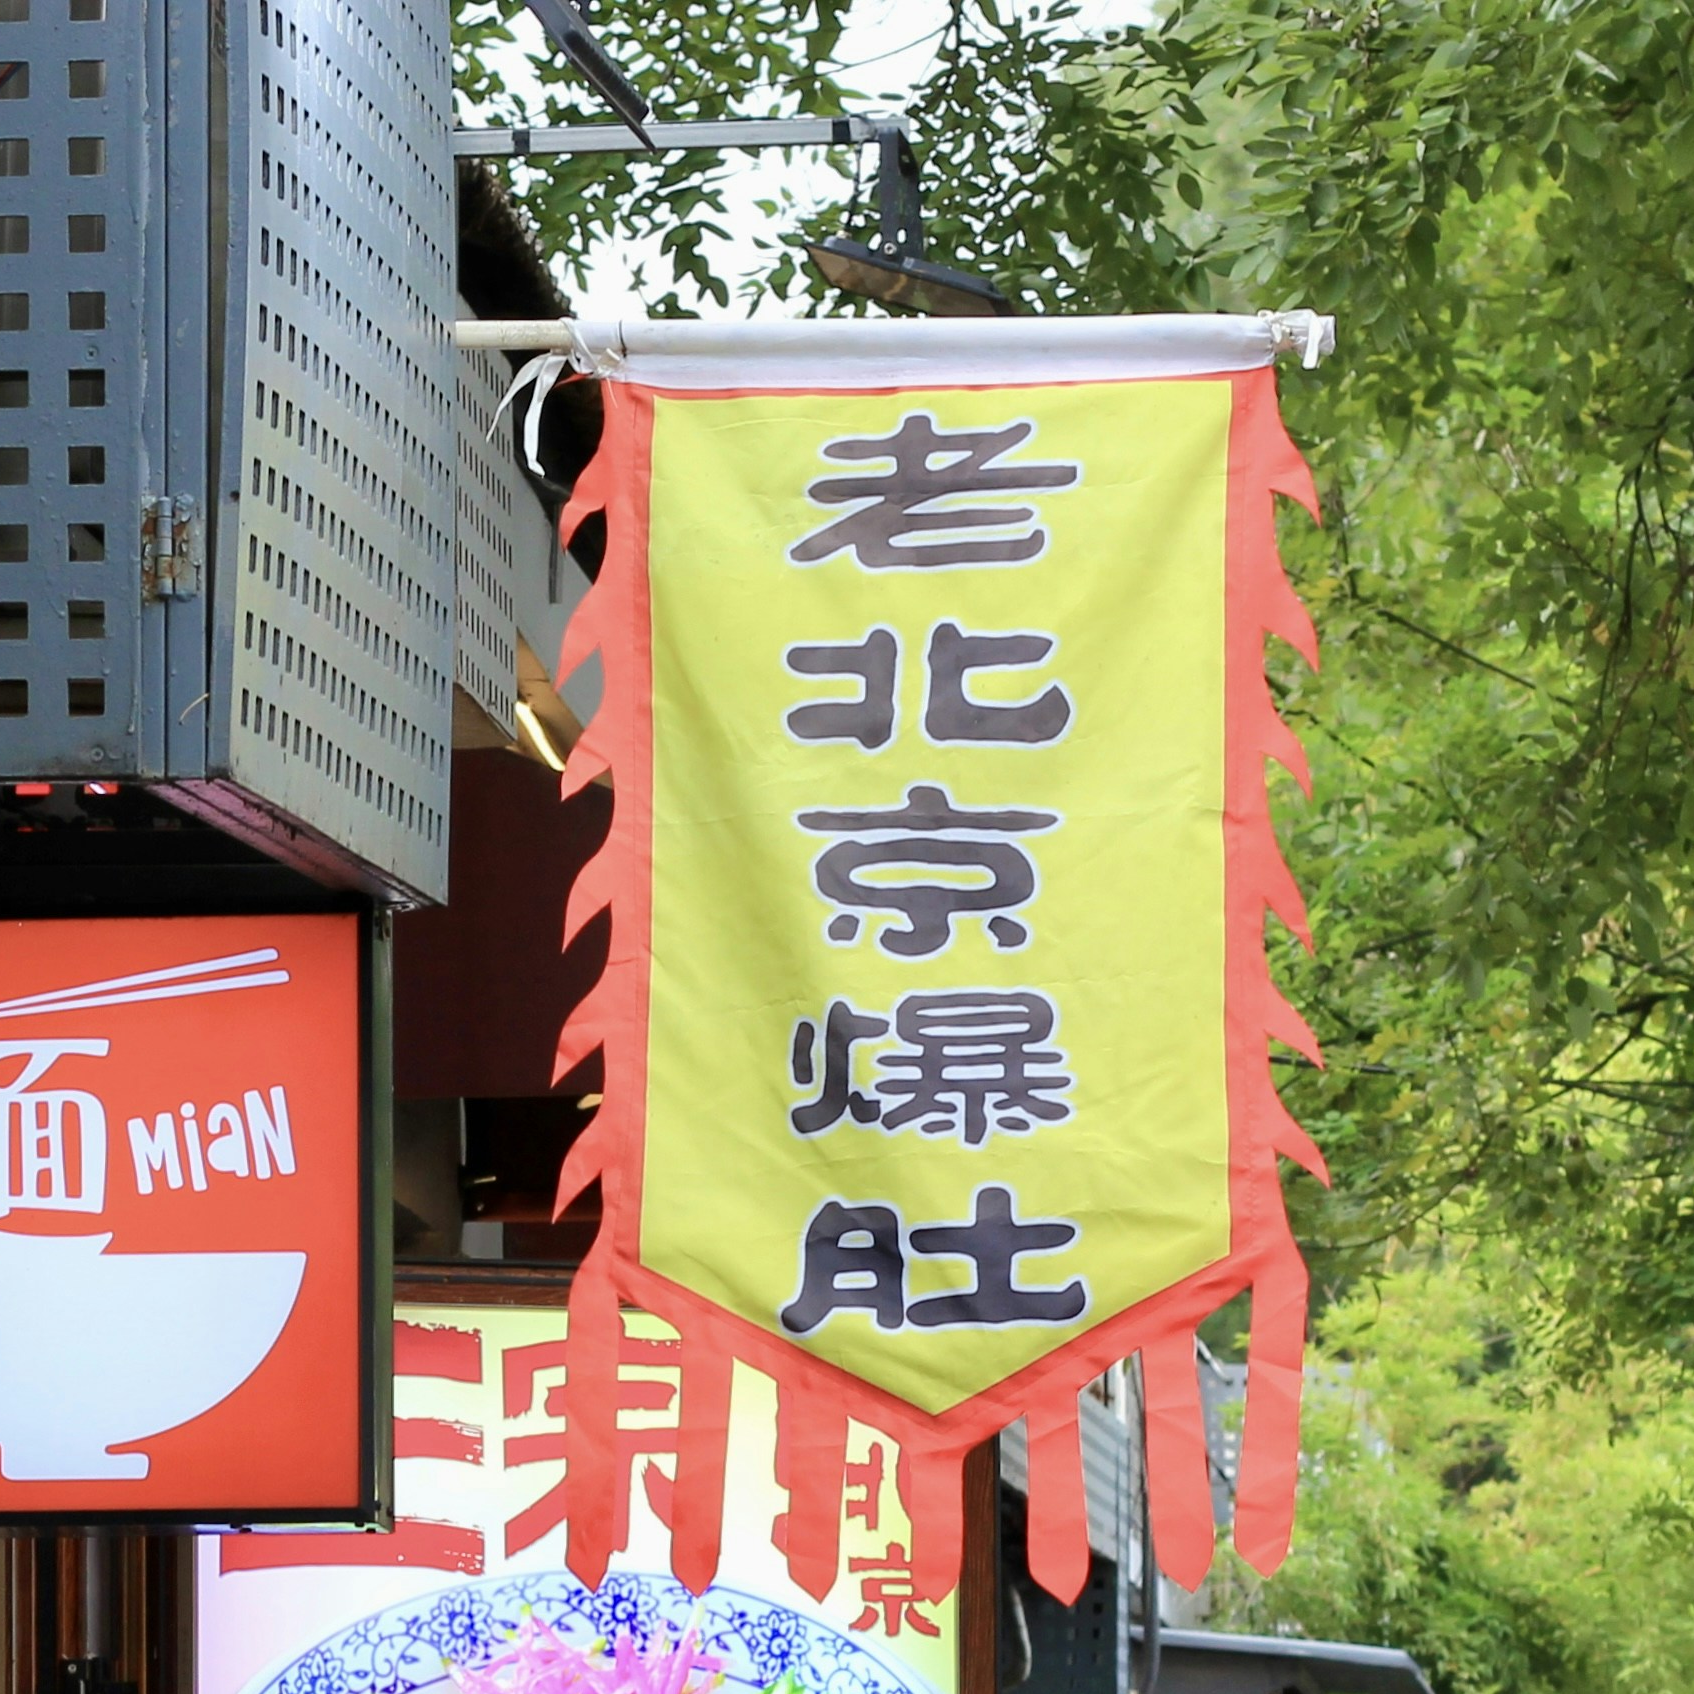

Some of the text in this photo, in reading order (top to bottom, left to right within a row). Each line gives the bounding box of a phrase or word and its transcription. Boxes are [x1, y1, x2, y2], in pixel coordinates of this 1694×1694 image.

[782, 410, 1089, 1335] 老北京爆肚
